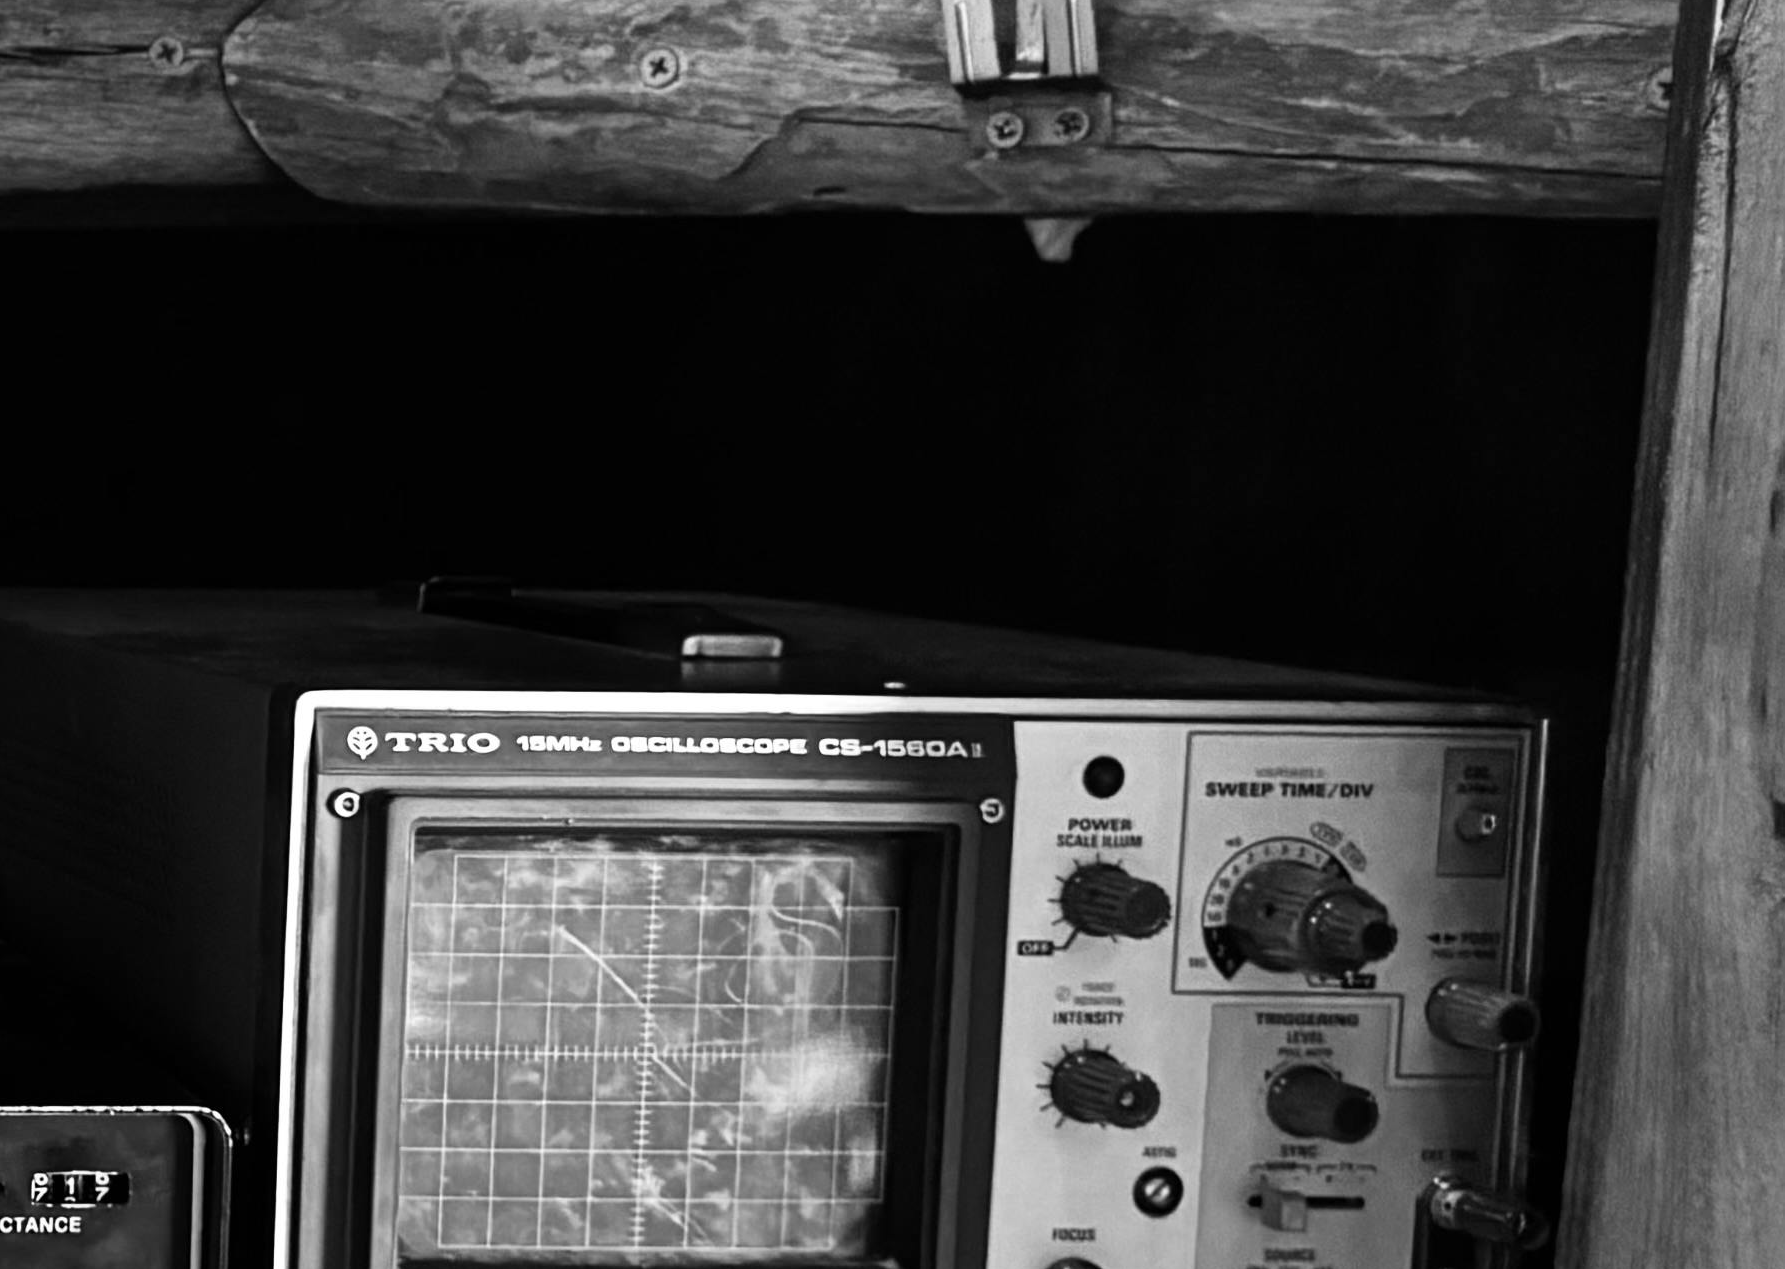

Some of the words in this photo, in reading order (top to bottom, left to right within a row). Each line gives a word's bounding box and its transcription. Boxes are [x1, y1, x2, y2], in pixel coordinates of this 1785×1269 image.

[385, 733, 500, 753] TRIO
[611, 737, 807, 754] OSCILLOSCOPE
[1206, 782, 1274, 797] SWEEP
[1068, 818, 1132, 832] POWER
[1054, 1011, 1123, 1024] INTENSITY
[1257, 1013, 1359, 1026] TRIGGERING
